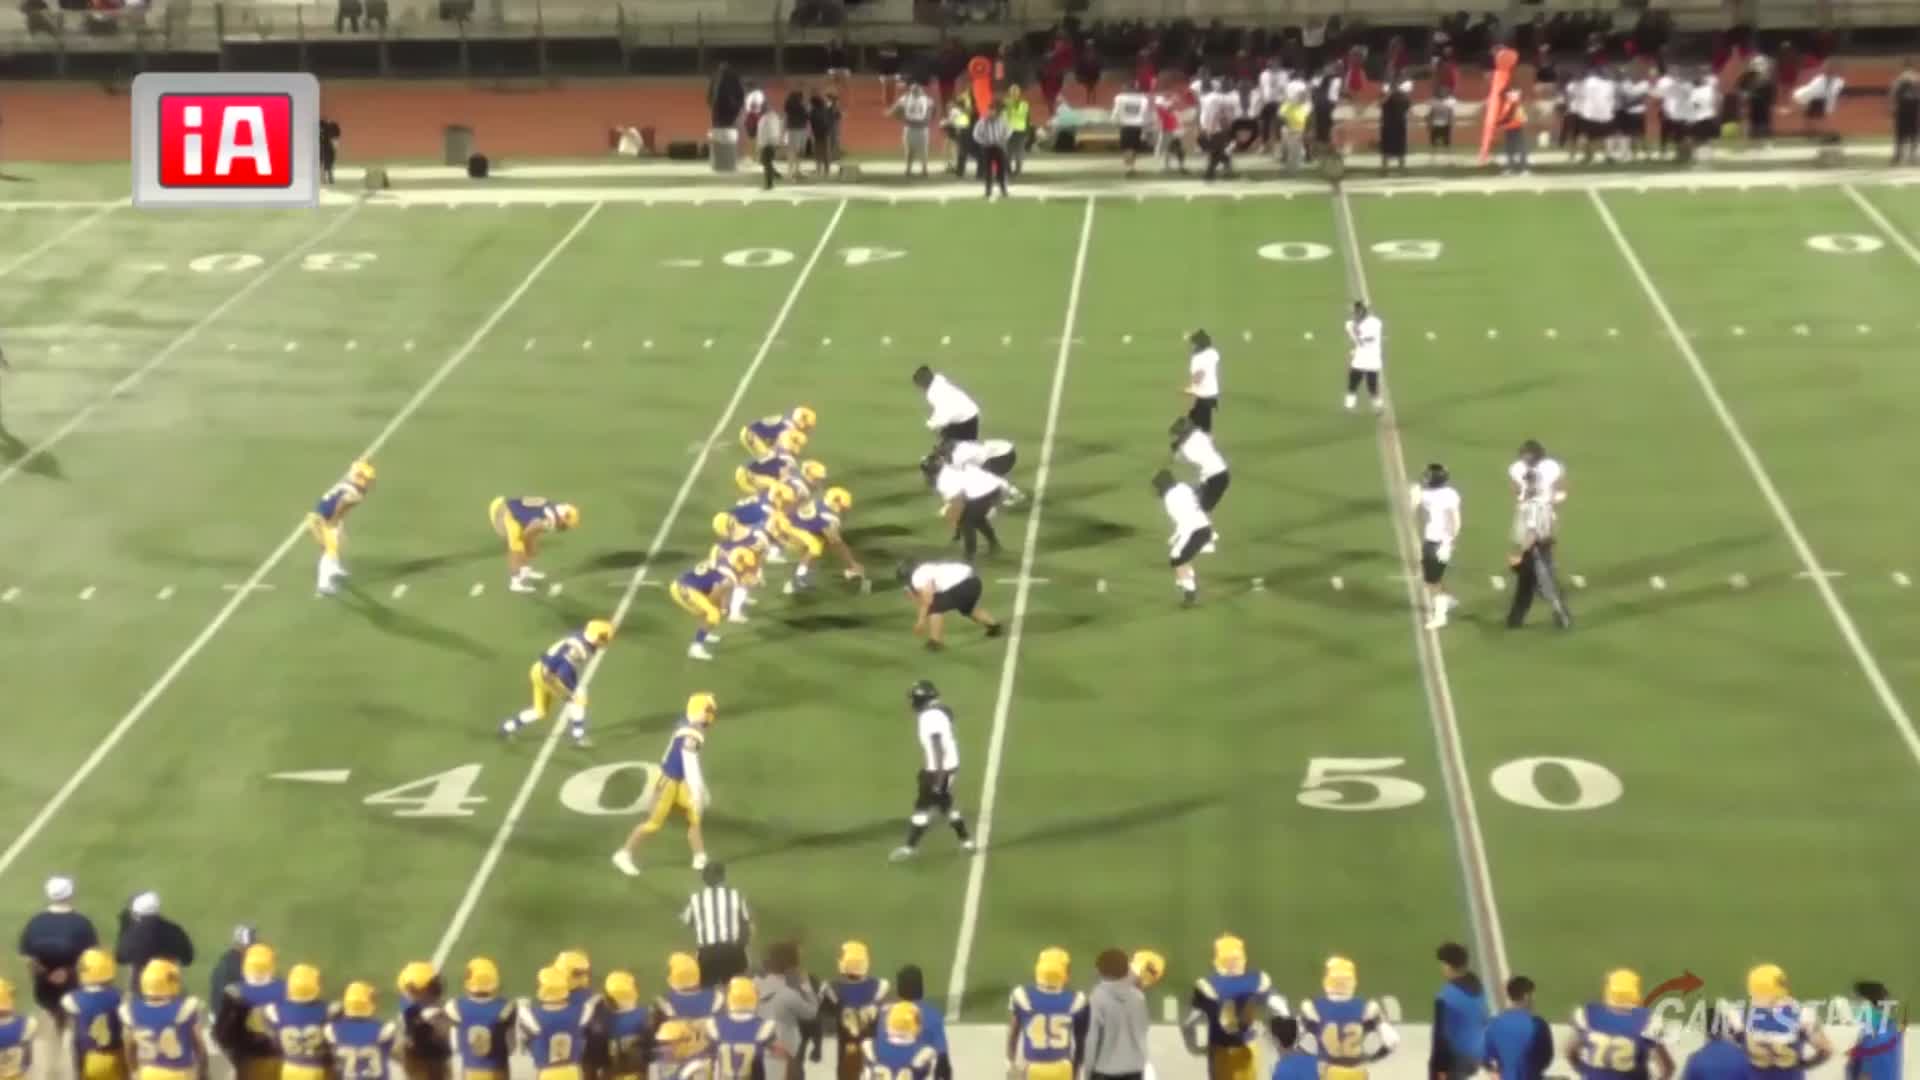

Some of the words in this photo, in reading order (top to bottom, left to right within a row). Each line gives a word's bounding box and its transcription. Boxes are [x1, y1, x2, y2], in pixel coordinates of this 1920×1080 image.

[1026, 1014, 1072, 1049] 45
[1319, 1022, 1363, 1057] 42
[717, 1042, 756, 1079] 17
